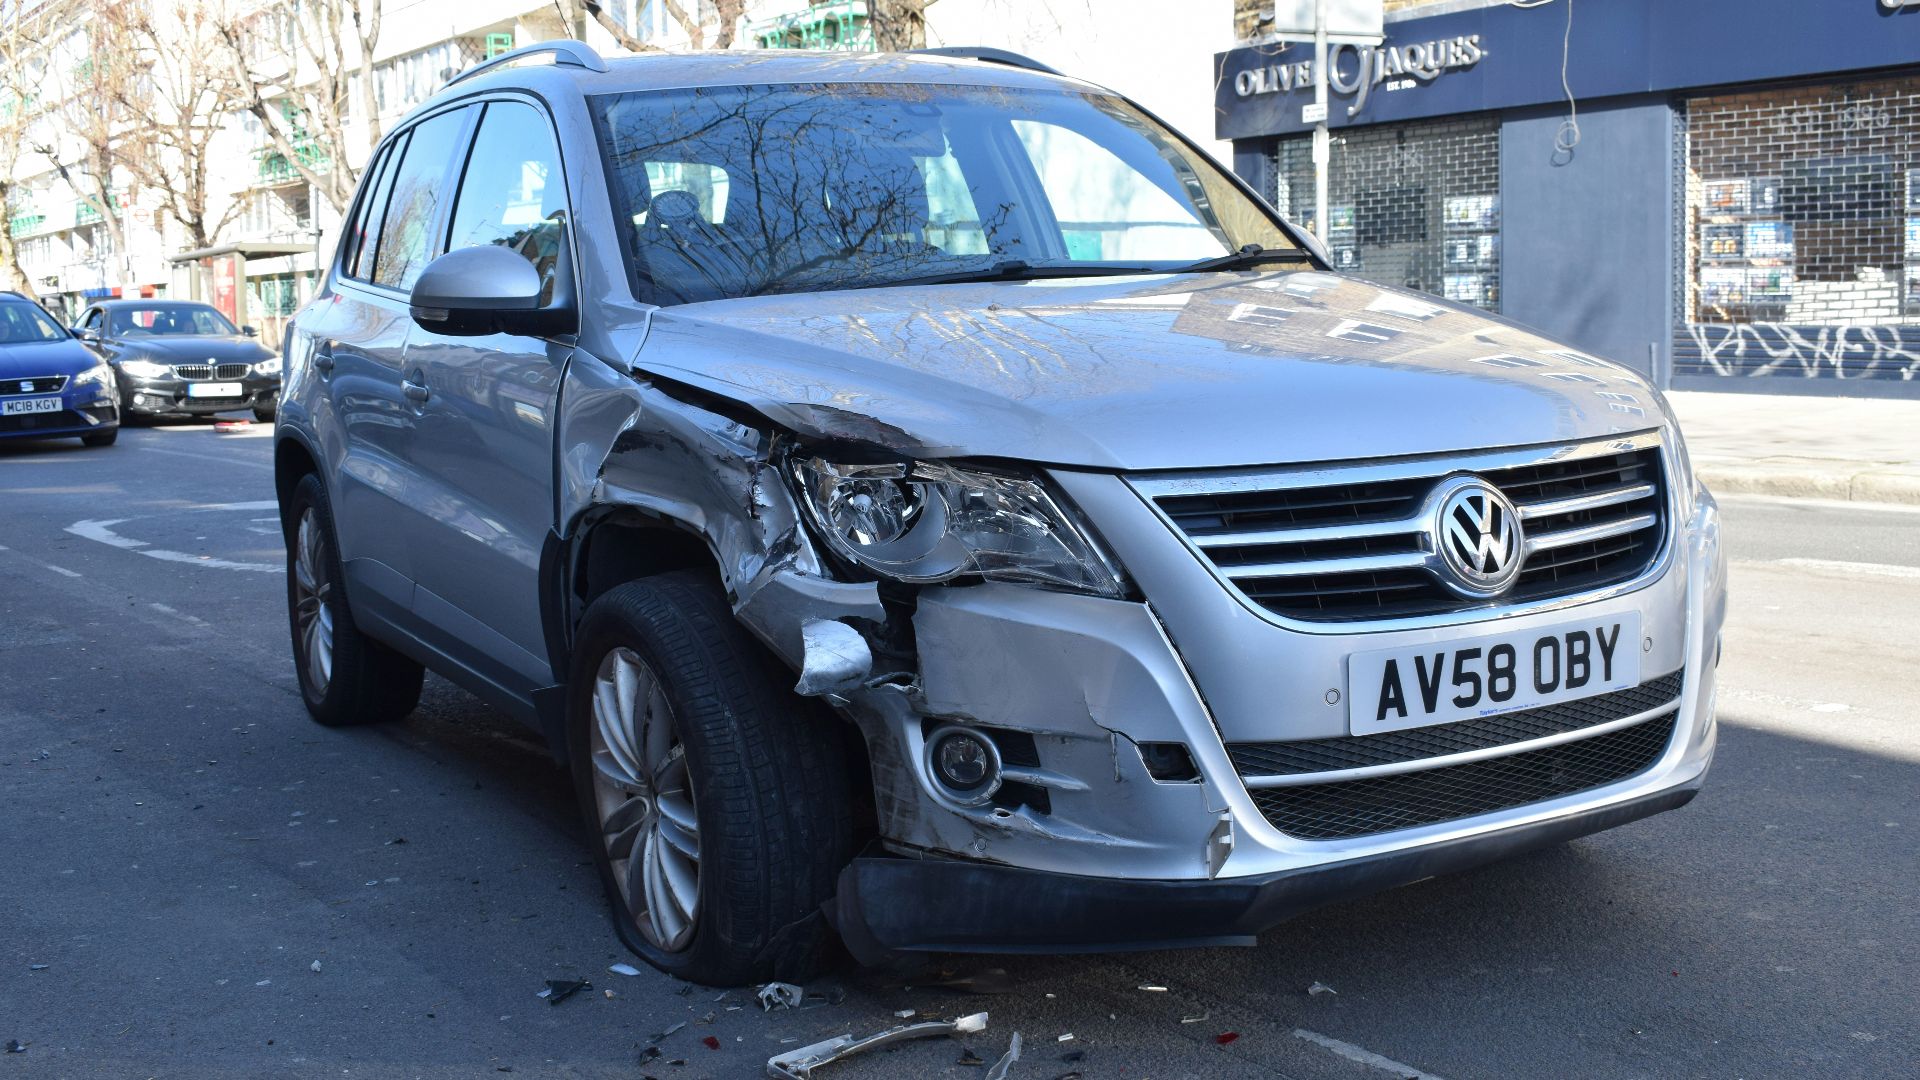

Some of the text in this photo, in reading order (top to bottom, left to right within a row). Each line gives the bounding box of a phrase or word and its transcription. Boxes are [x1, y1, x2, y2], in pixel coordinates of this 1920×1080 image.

[7, 399, 57, 412] MC18 KGV
[1376, 623, 1620, 720] AV58 OBY
